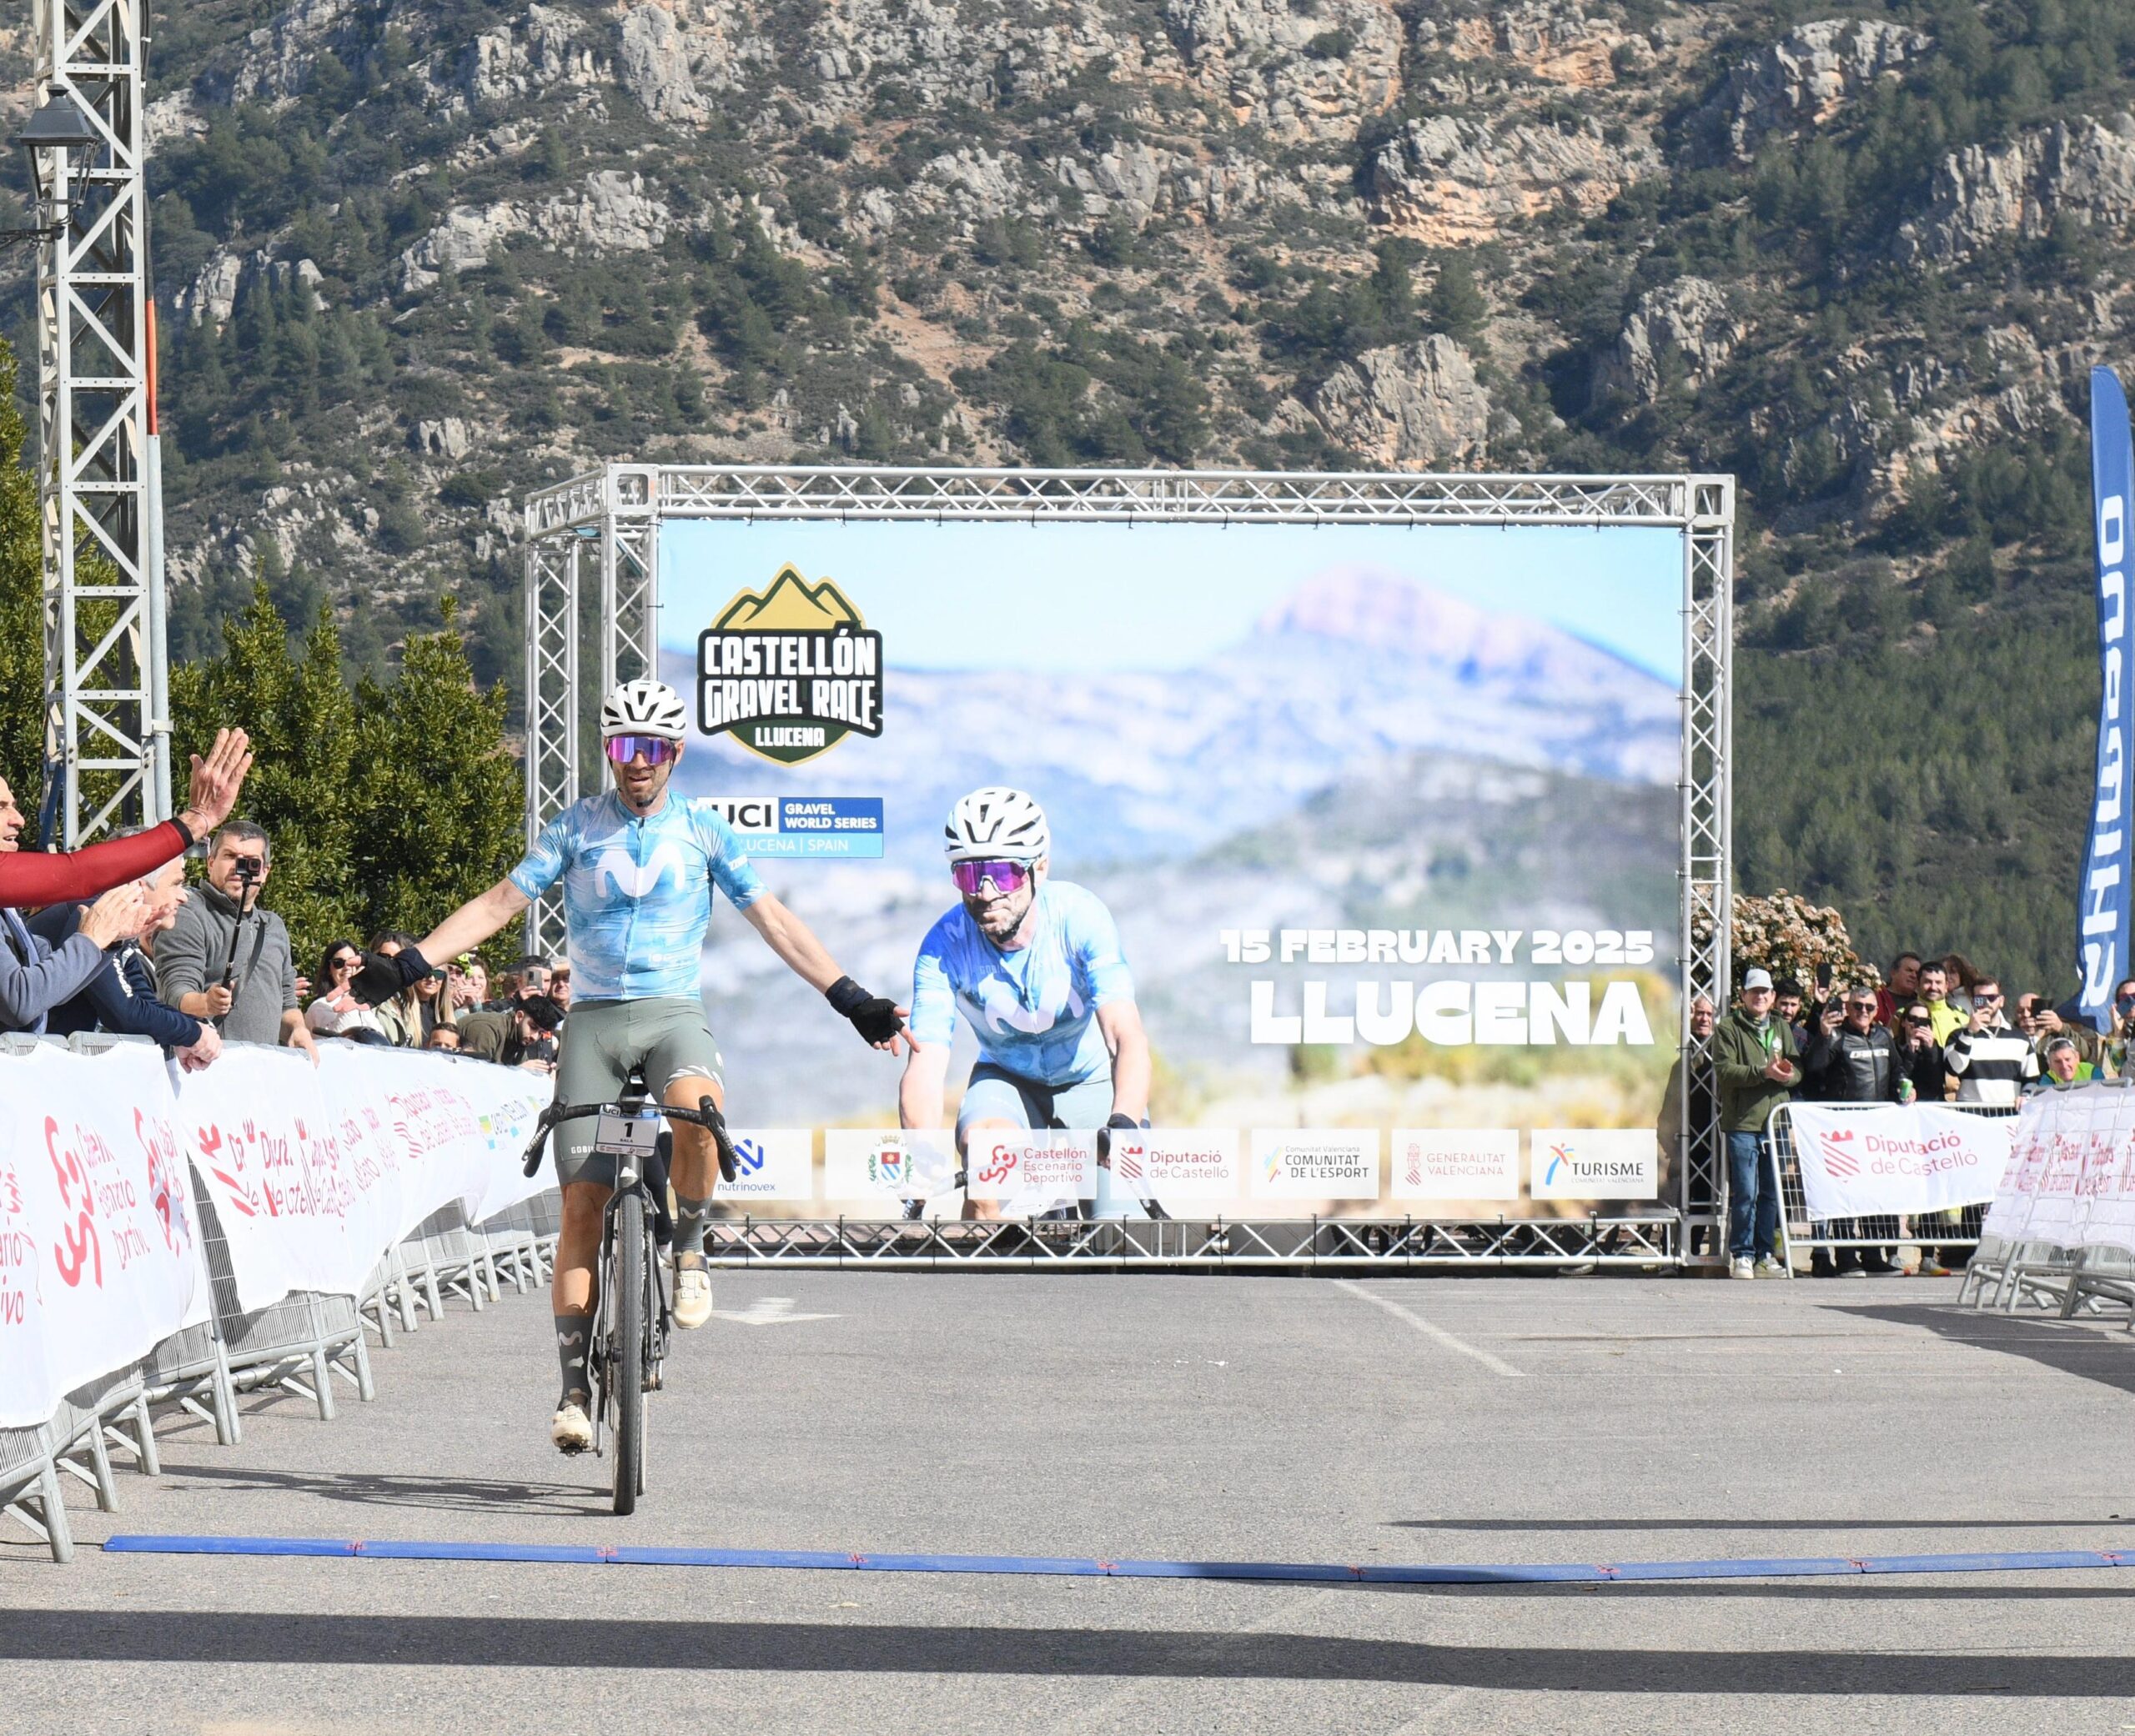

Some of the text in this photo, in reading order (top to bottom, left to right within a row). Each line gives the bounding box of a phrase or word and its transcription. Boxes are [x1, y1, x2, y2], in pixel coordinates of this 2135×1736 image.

[705, 628, 876, 675] CASTELLÓN
[705, 679, 876, 730] GRAVEL RACE
[755, 727, 825, 746] LLUCENA
[785, 804, 836, 815] GRAVEL
[785, 817, 877, 829] WORLD SERIES
[744, 839, 849, 851] UCENA SPAIN
[1220, 930, 1655, 965] 15 FEBRUARY 2025
[1251, 980, 1655, 1046] LLUCENA
[624, 1121, 634, 1138] 1
[1865, 1130, 1961, 1157] Diputació
[1023, 1146, 1088, 1159] Castellón
[1150, 1150, 1223, 1167] Diputació
[1426, 1152, 1506, 1163] GENERALITAT
[1023, 1160, 1083, 1172] Escenario
[1285, 1155, 1360, 1166] COMUNITAT
[1871, 1148, 1978, 1177] de Castelló
[1150, 1165, 1230, 1179] de Castelló
[1291, 1167, 1369, 1178] DE L'ESPORT
[1427, 1166, 1505, 1176] VALENCIANA
[1572, 1162, 1645, 1176] TURISME
[1023, 1172, 1083, 1185] Deportivo
[718, 1182, 776, 1192] nutrinovex
